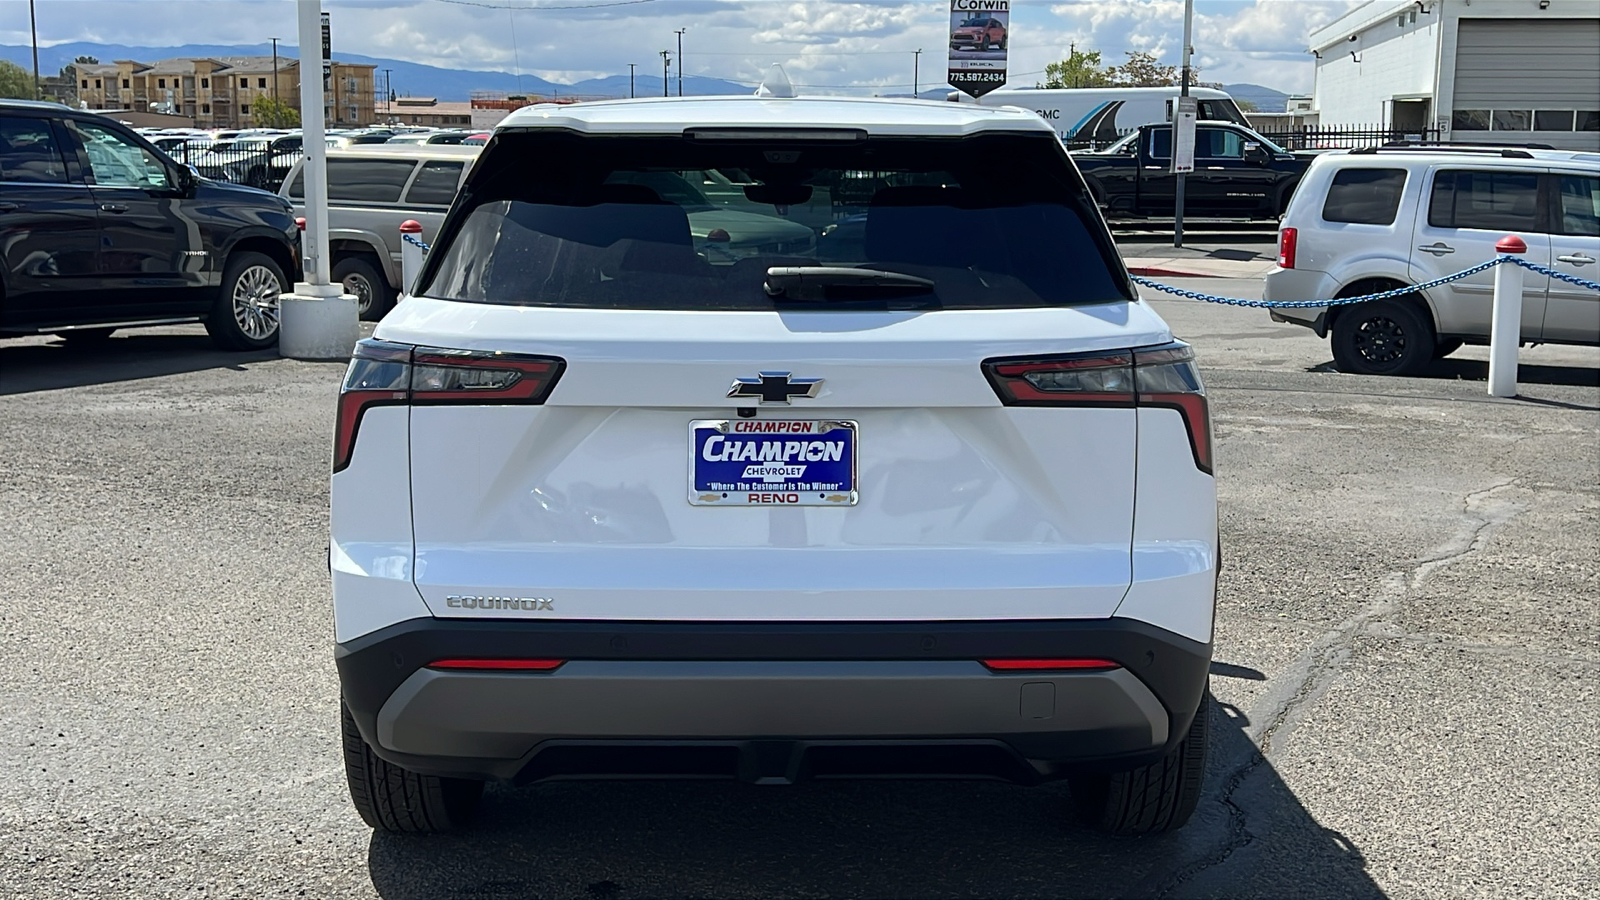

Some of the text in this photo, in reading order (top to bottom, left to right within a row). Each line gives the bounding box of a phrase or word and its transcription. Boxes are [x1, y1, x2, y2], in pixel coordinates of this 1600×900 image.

[957, 0, 1008, 9] Corwin
[949, 72, 1004, 82] 775.587.2434
[735, 422, 812, 433] CHAMPION
[702, 435, 844, 462] CHAMPION
[746, 467, 802, 476] CHEVROLET
[737, 482, 750, 491] The
[752, 482, 787, 491] Customer
[788, 482, 796, 491] Is
[797, 482, 811, 491] The
[748, 493, 799, 503] RENO
[446, 595, 554, 611] EQUINOX
